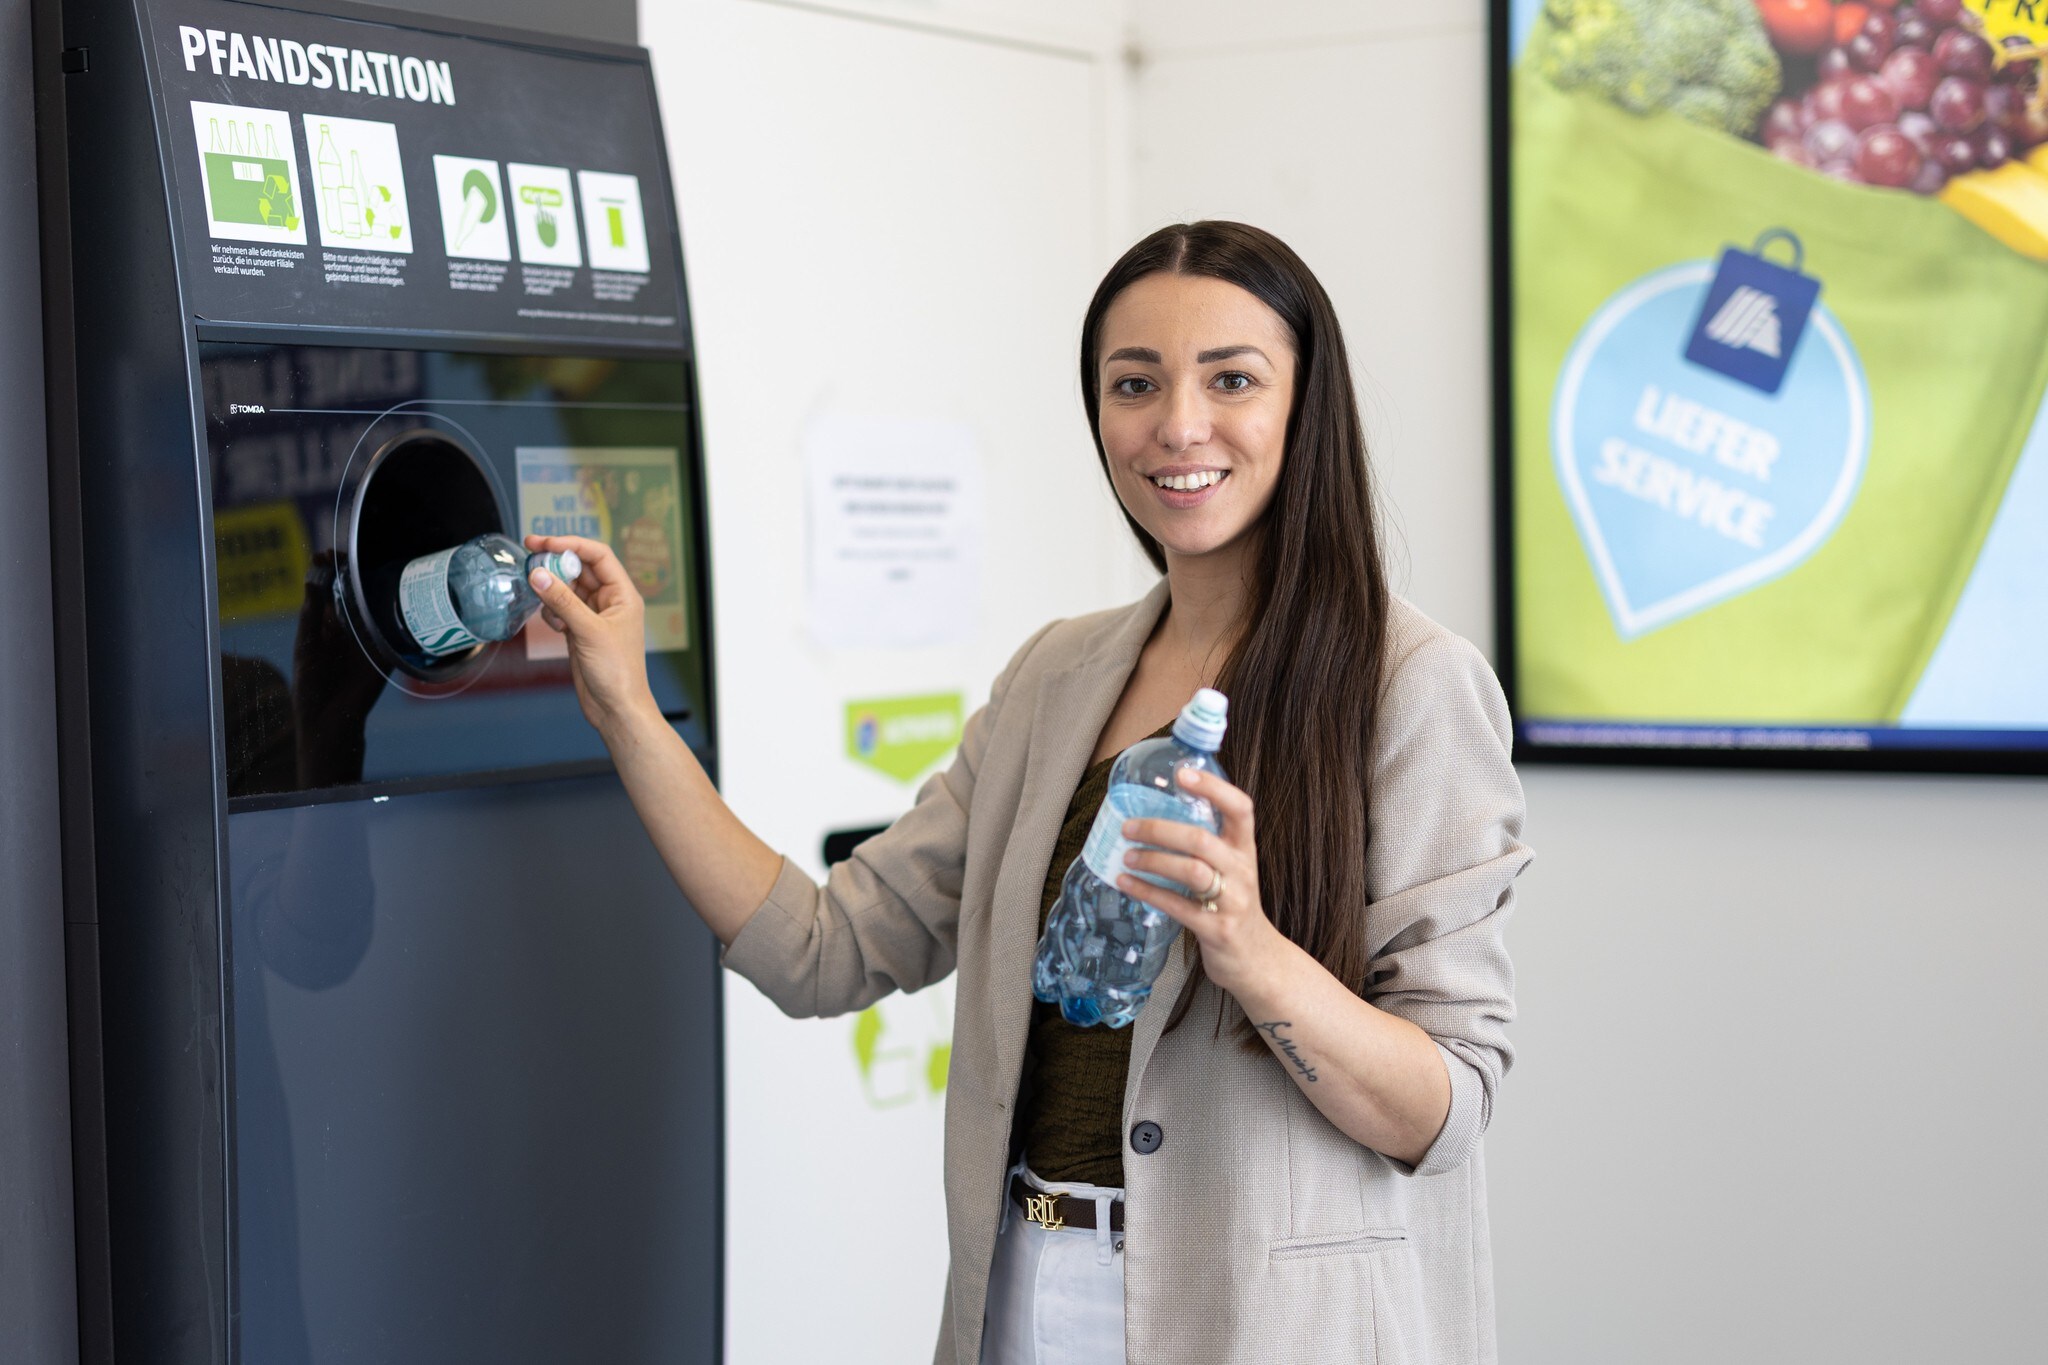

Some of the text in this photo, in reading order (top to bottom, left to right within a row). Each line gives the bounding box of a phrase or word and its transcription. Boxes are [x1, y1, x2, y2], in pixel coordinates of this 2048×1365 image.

[179, 25, 456, 106] PFANDSTATION
[211, 244, 305, 260] Wir nehmen alle Getränkekisten
[322, 252, 336, 262] Bitte
[336, 254, 348, 262] nur
[212, 254, 295, 268] zurück, die in unserer Filiale
[213, 265, 266, 277] verkauft wurden.
[353, 264, 365, 273] und
[237, 404, 266, 414] TOMRA
[1634, 384, 1780, 484] LIEFER
[1593, 436, 1776, 549] SERVICE
